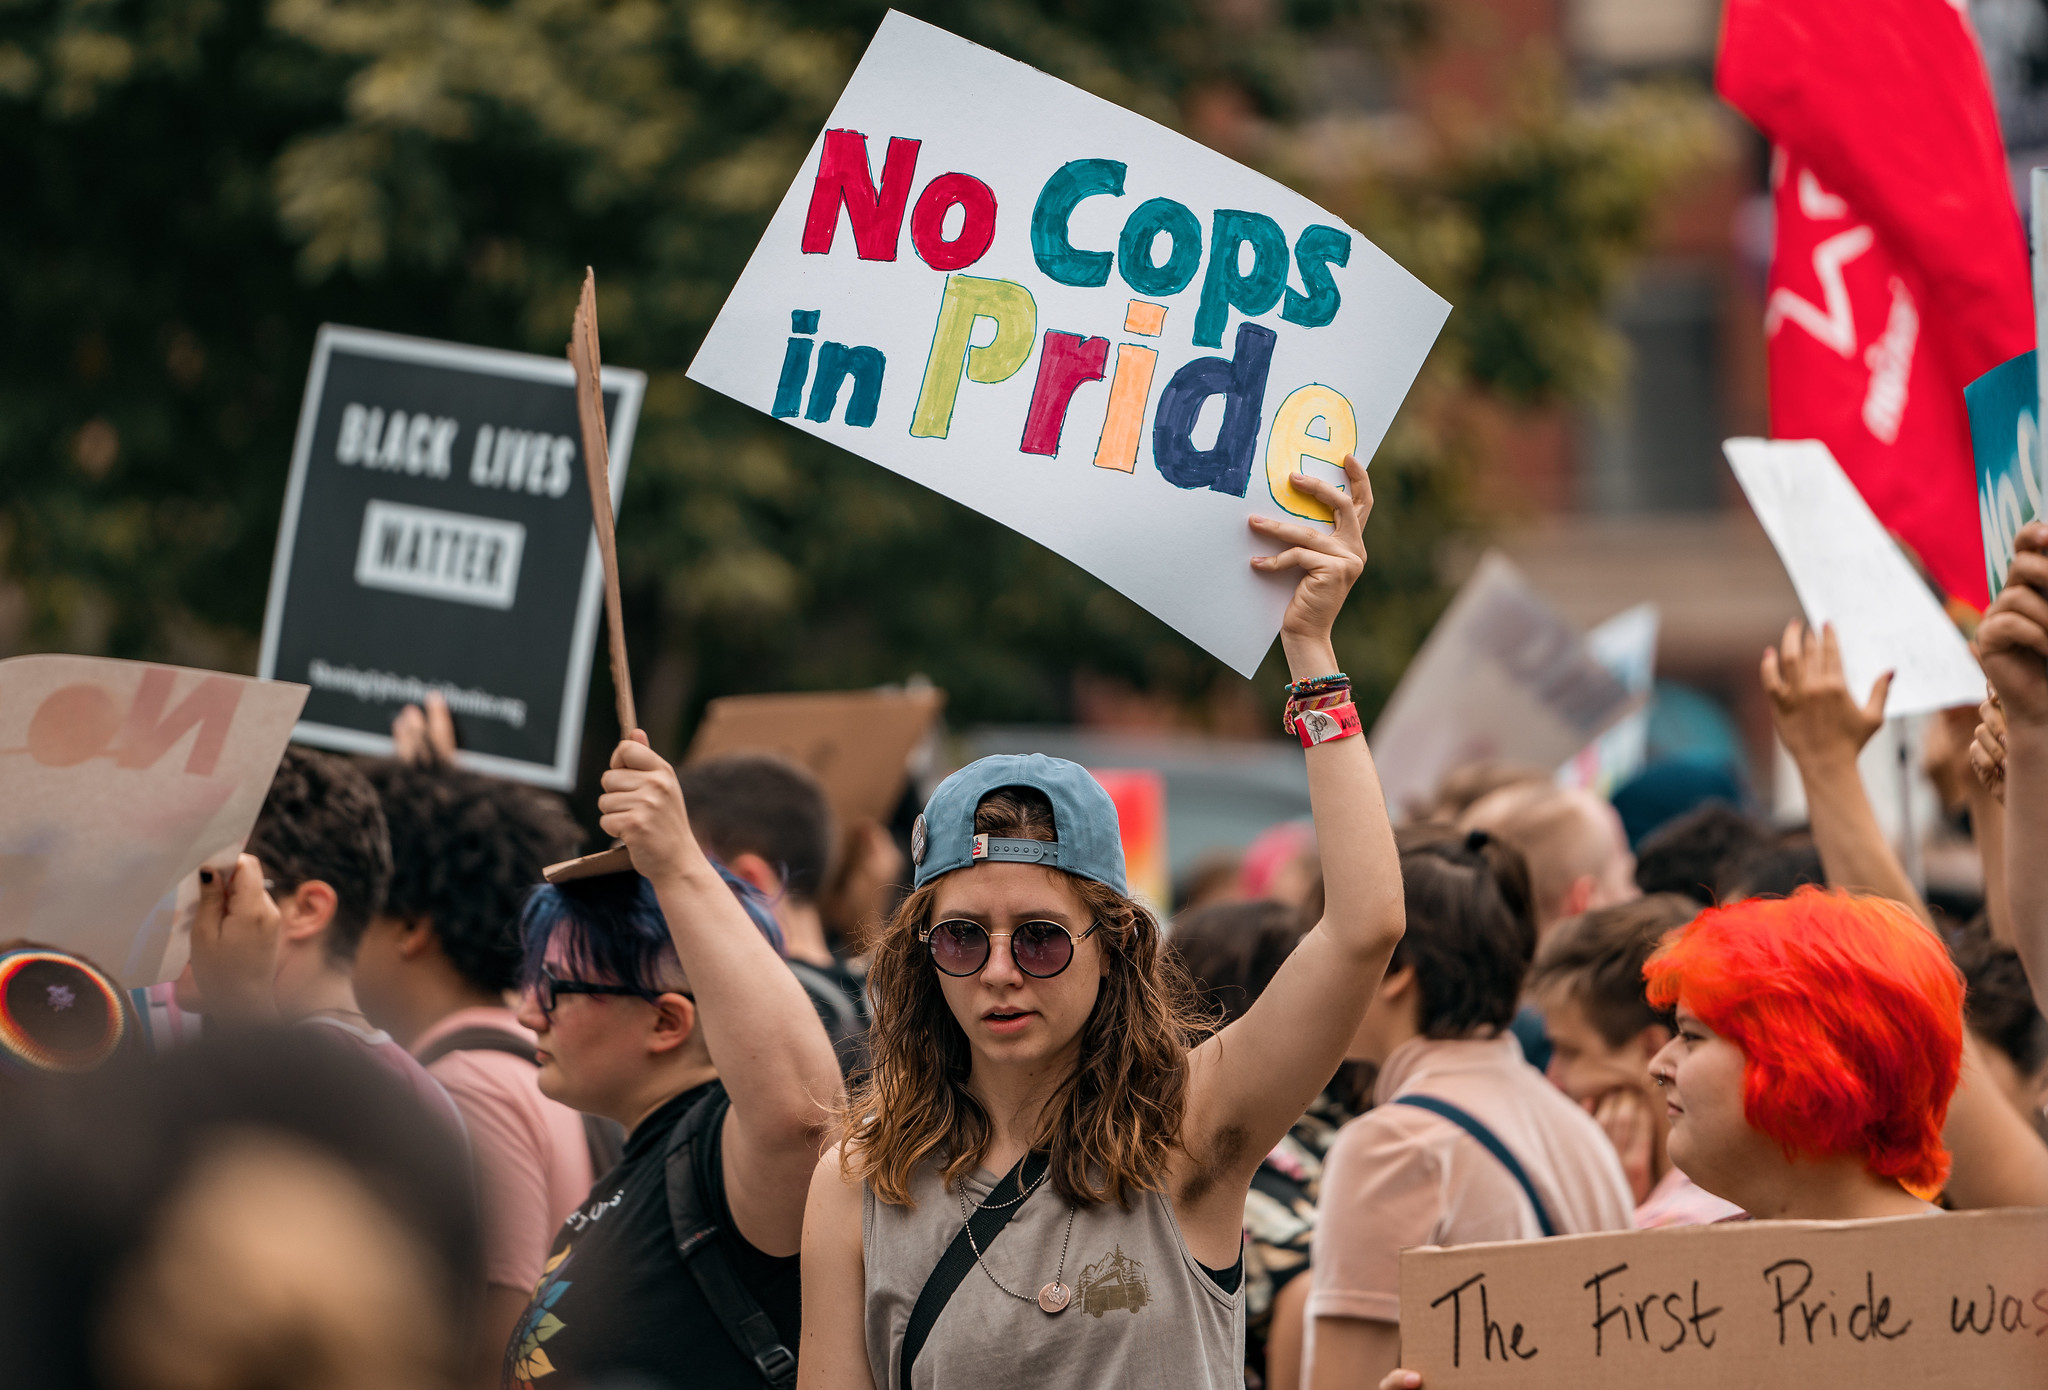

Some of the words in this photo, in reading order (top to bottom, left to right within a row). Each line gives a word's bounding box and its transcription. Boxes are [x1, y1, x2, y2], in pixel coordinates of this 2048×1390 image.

[801, 128, 998, 271] No
[1030, 158, 1351, 348] Cops
[336, 403, 459, 479] BLACK
[469, 423, 576, 497] LIVES
[771, 309, 886, 428] in
[909, 274, 1357, 523] Pride
[377, 518, 507, 585] MATTER
[1430, 1272, 1538, 1368] The
[1583, 1263, 1723, 1357] First
[1763, 1259, 1912, 1346] Pride
